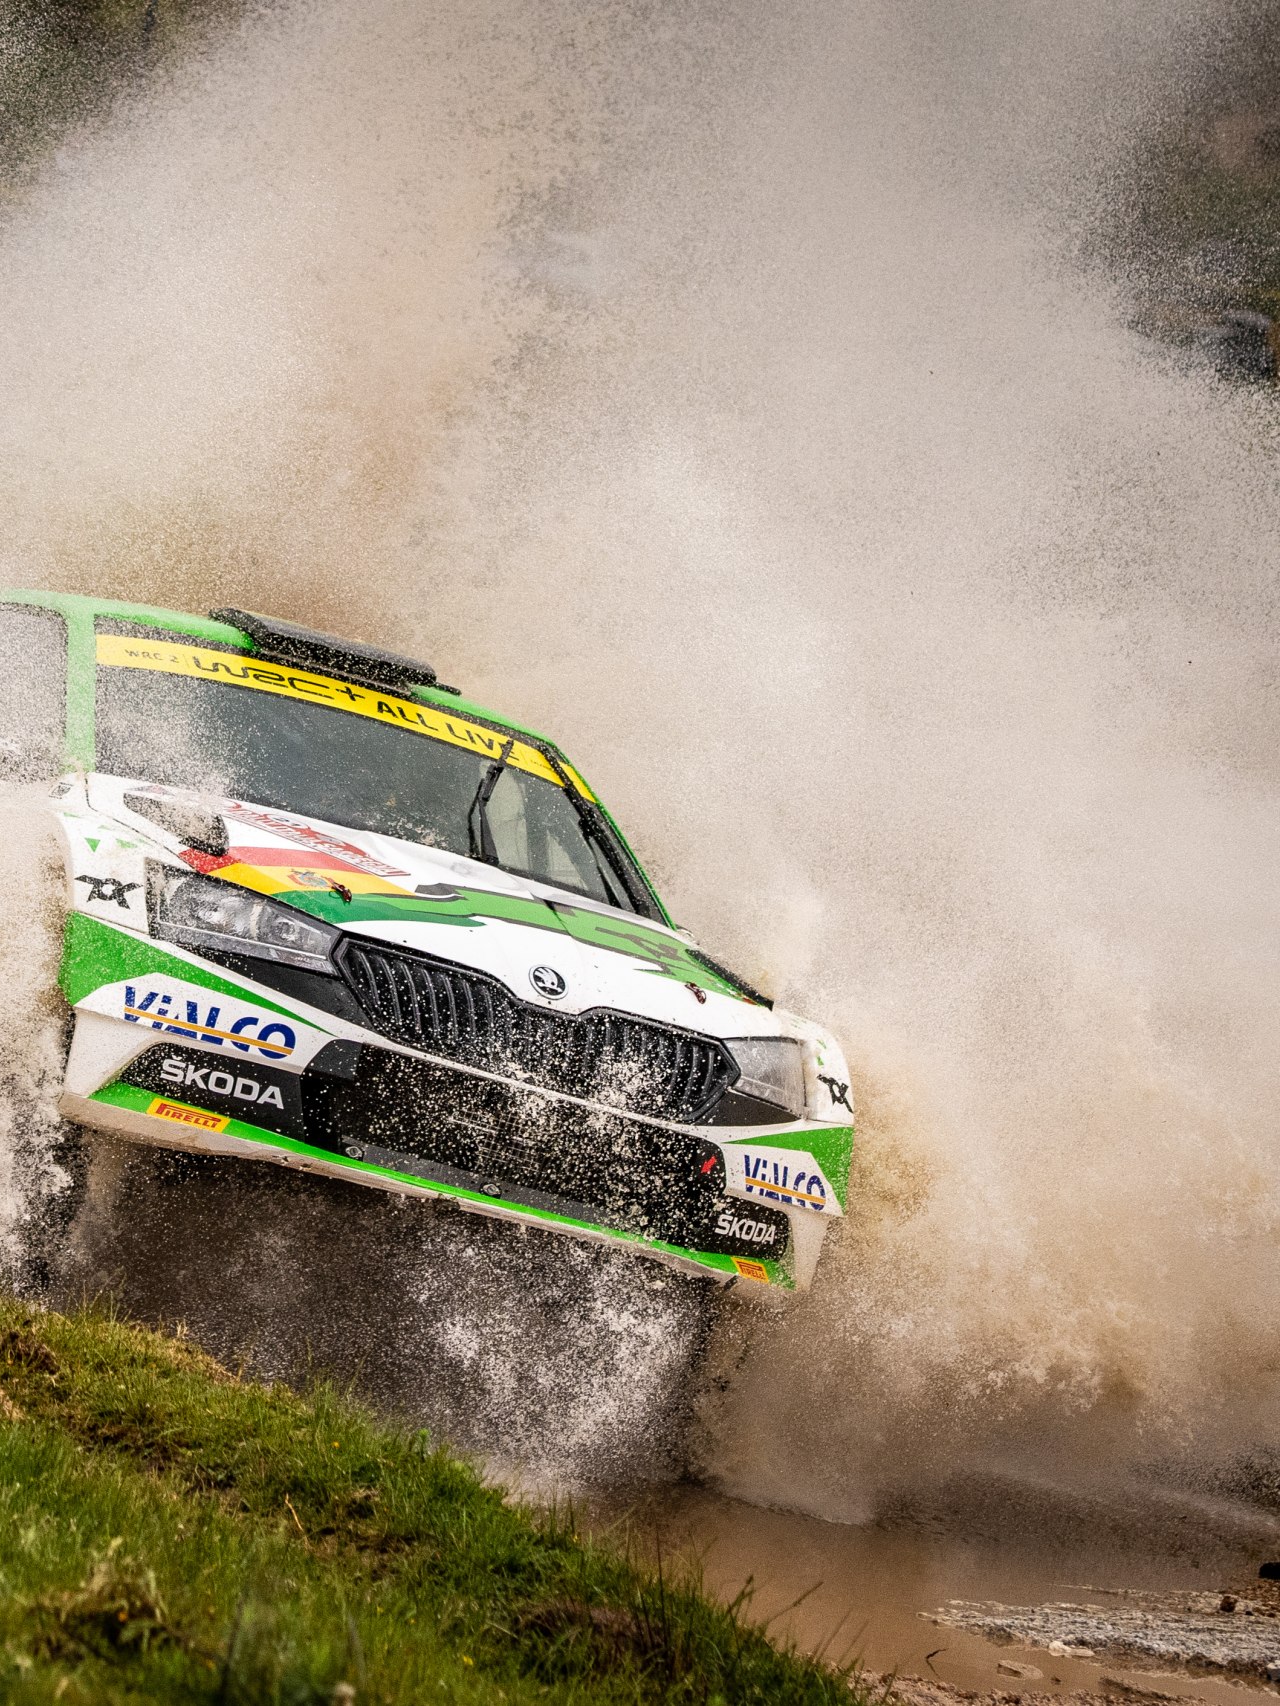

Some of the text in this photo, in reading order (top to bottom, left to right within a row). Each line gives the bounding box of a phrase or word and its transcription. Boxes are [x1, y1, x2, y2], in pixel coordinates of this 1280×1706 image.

[124, 649, 163, 661] WRC
[376, 700, 438, 731] ALL
[160, 1055, 284, 1109] ŠKODA
[156, 1102, 222, 1128] PIRELLI
[714, 1209, 776, 1245] ŠKODA
